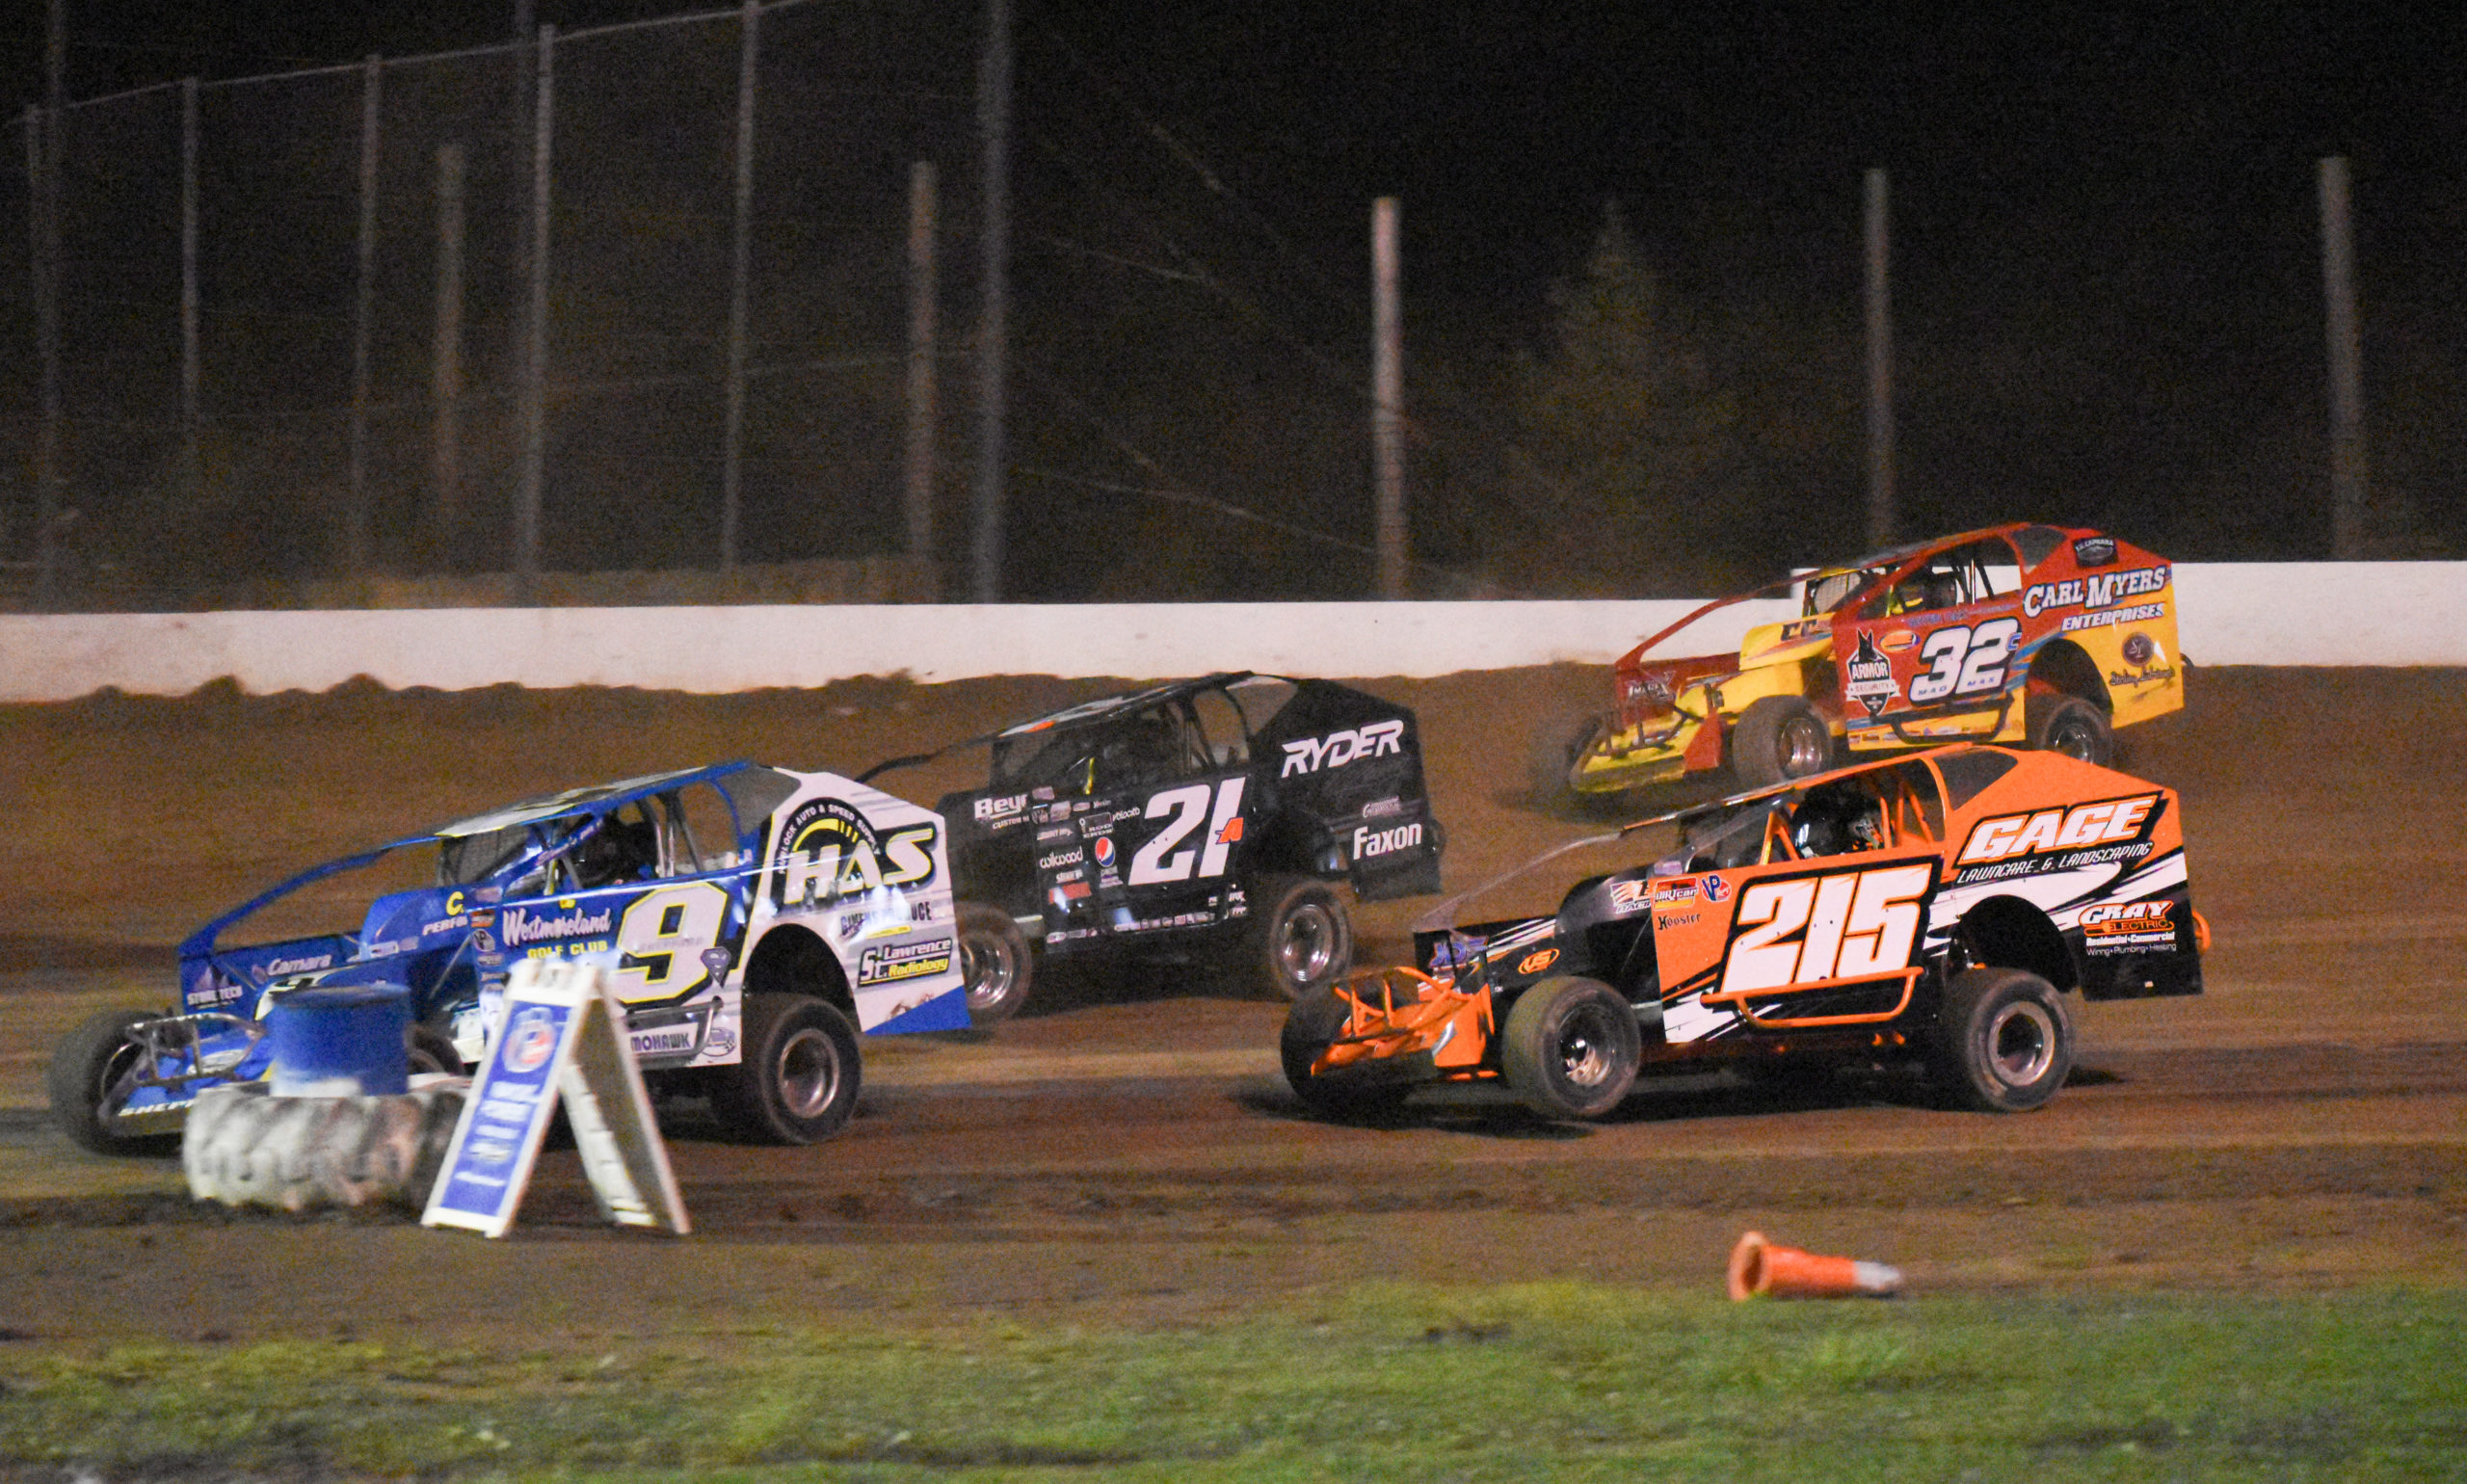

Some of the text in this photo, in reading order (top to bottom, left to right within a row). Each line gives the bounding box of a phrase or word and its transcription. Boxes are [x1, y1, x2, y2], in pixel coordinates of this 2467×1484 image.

[2024, 580, 2083, 618] CARL
[2085, 566, 2166, 609] MYERS
[2061, 603, 2165, 631] ENTERPRISES
[1851, 662, 1889, 679] ARMOR
[1909, 617, 2020, 703] 32
[1854, 681, 1889, 693] SECURITY
[1281, 720, 1404, 779] RYDER
[795, 808, 817, 827] AUTO
[829, 804, 856, 821] SPEED
[856, 819, 881, 856] SUPPLY
[993, 819, 1021, 830] CUSTOM
[1128, 777, 1246, 886] 21
[1960, 797, 2156, 863] GAGE
[1353, 823, 1422, 860] Faxon
[783, 826, 935, 905] HAS
[1040, 846, 1083, 869] wilwood
[1957, 841, 2153, 884] LAWNCARE & LANDSCAPING
[1701, 875, 1721, 902] VP
[1658, 913, 1701, 931] Hoosier
[2082, 901, 2171, 925] GRAY
[2109, 919, 2168, 933] ELECTRIC
[1724, 864, 1930, 993] 215
[527, 941, 607, 961] GOLF CLUB
[614, 882, 729, 1005] 9
[884, 939, 951, 961] Lawrence
[2113, 945, 2146, 955] Plumbing
[888, 957, 949, 976] Radiology
[630, 1034, 691, 1052] MOHAWK
